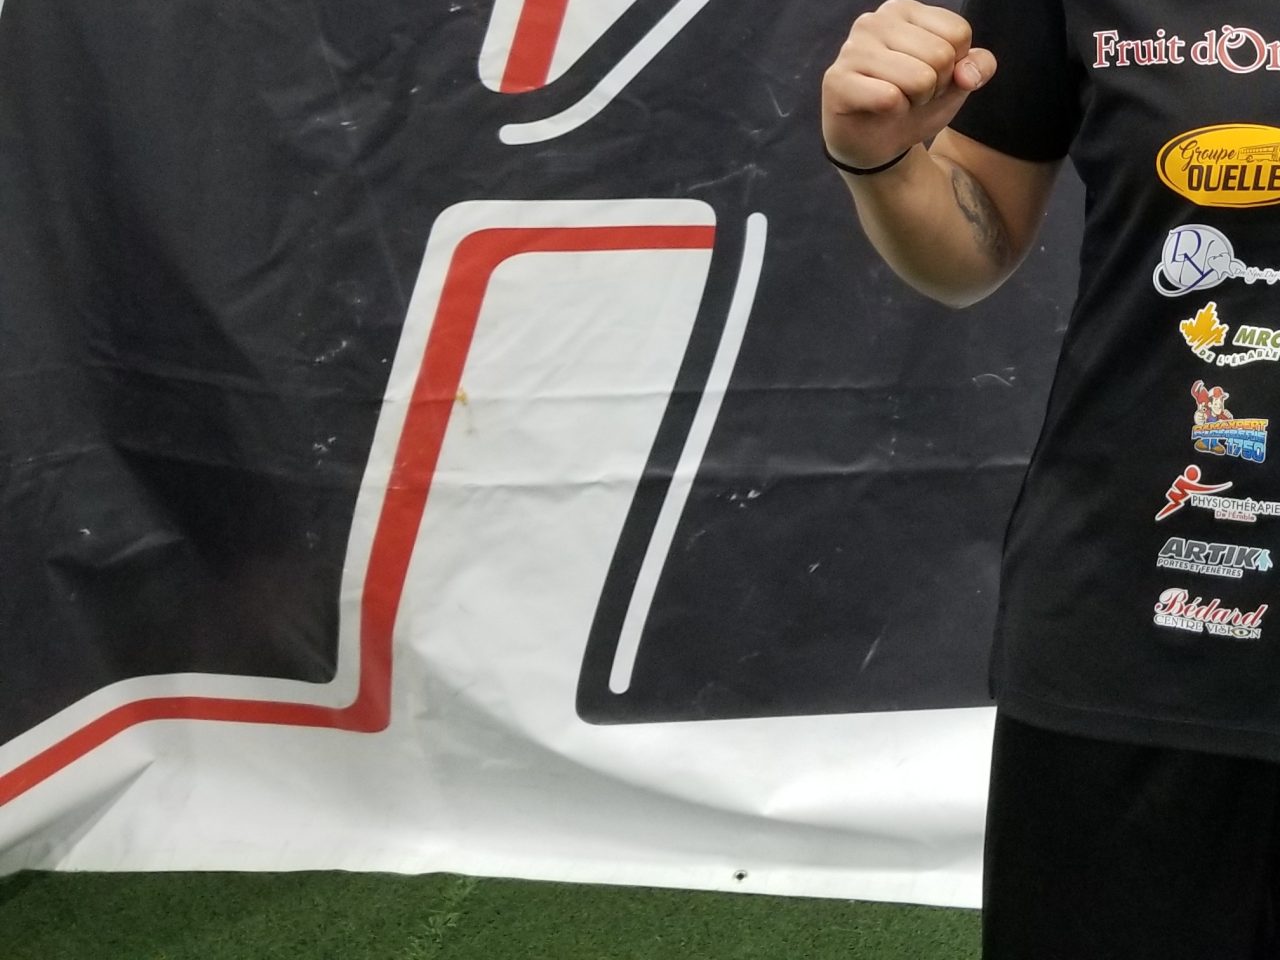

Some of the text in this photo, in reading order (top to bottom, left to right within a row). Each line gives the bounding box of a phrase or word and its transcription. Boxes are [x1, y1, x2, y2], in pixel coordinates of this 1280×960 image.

[1093, 29, 1185, 68] Fruit
[1179, 140, 1237, 171] Groupe
[1200, 349, 1215, 361] DE
[1225, 439, 1266, 462] 1750
[1191, 495, 1280, 514] PHYSIOTHÉRAPIE
[1159, 537, 1262, 569] ARTIK
[1157, 558, 1242, 577] PORTES ET FENÊTRES
[1155, 588, 1268, 627] Bédard
[1154, 615, 1203, 631] CENTRE
